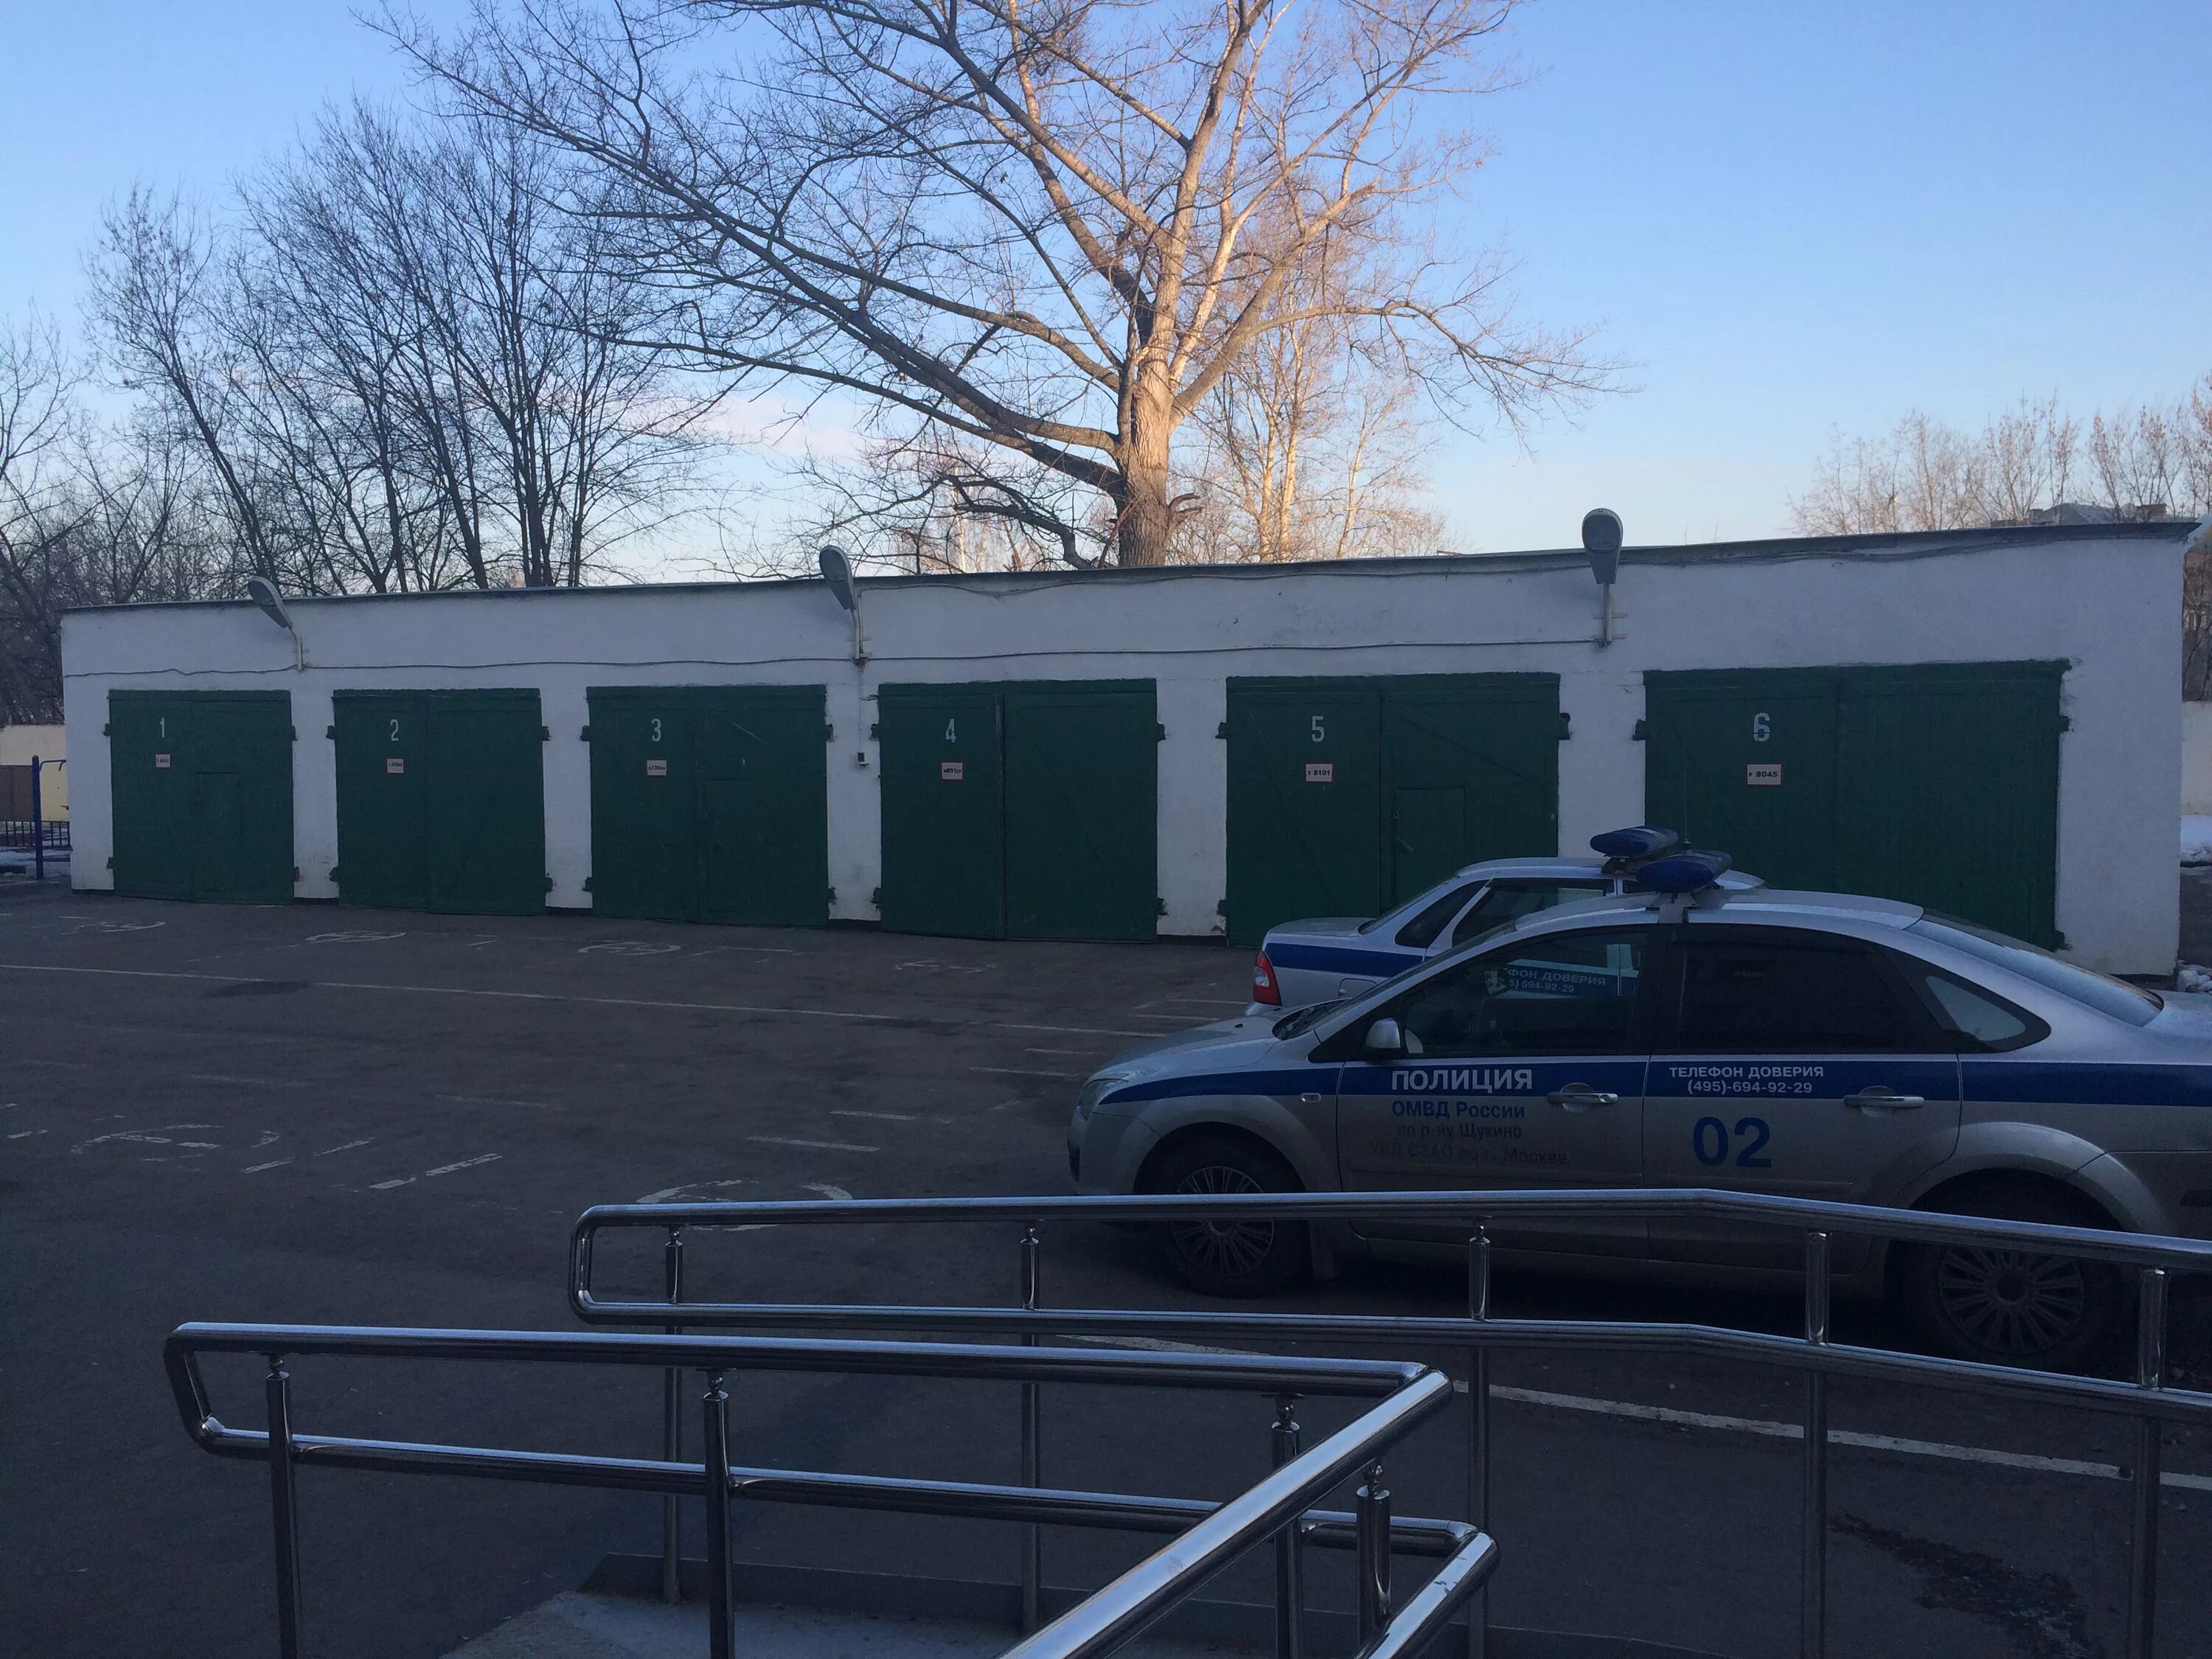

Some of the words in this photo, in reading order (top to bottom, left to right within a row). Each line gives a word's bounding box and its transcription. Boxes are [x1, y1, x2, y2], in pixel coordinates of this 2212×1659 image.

[159, 717, 165, 739] 1
[390, 719, 399, 742] 2
[651, 718, 661, 742] 3
[945, 718, 956, 743] 4
[1311, 716, 1325, 742] 5
[1753, 712, 1771, 742] 6
[1521, 980, 1575, 993] 694-92-29
[1541, 972, 1607, 986] ДОВЕРИЯ
[1391, 1068, 1534, 1094] ПОЛИЦИЯ
[1669, 1066, 1744, 1078] ТЕЛЕФОН
[1747, 1066, 1825, 1079] ДОВЕРИЯ
[1687, 1079, 1814, 1096] (495)-694-92-29
[1391, 1100, 1450, 1119] ОМВД
[1455, 1101, 1526, 1119] России
[1398, 1124, 1416, 1137] по
[1420, 1124, 1454, 1139] р-ну
[1459, 1121, 1523, 1141] Щукино
[1693, 1116, 1773, 1168] 02
